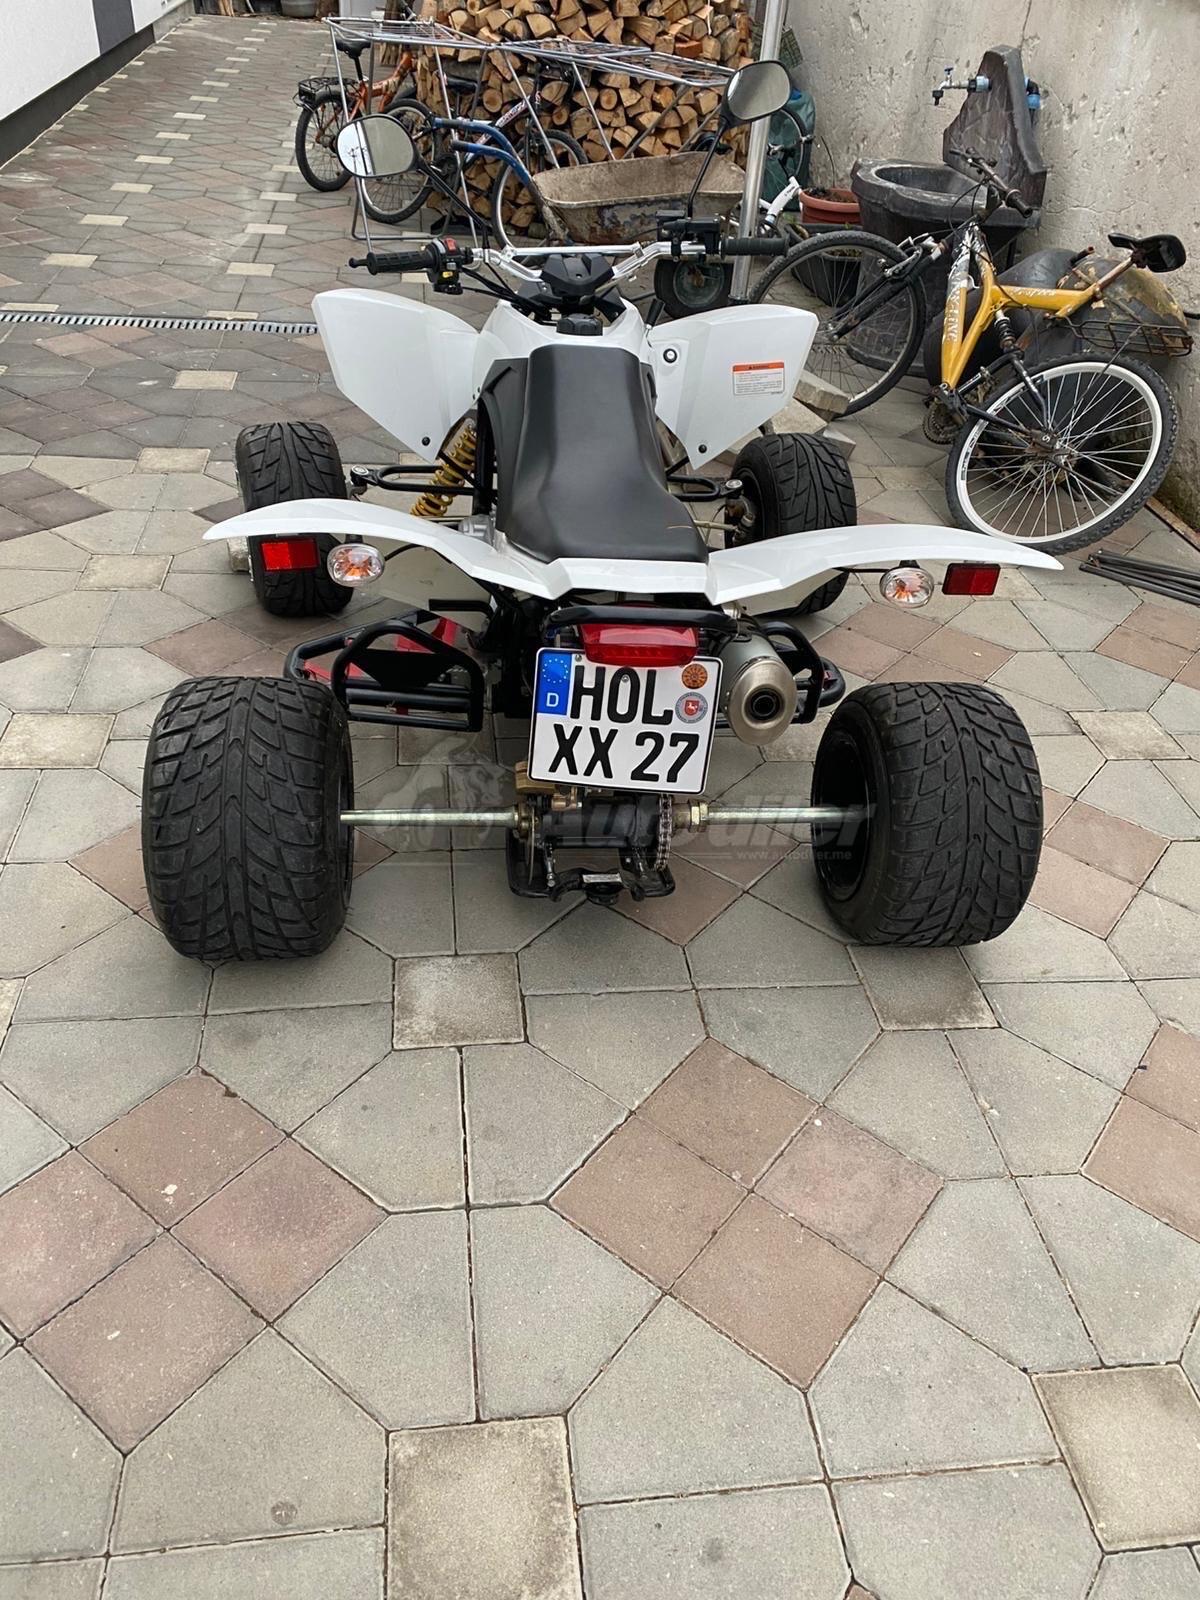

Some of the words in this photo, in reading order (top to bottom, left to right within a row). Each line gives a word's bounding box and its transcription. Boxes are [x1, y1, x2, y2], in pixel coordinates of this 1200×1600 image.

[546, 692, 559, 707] D
[570, 665, 674, 726] HOL
[549, 723, 619, 779] XX
[630, 731, 700, 783] 27
